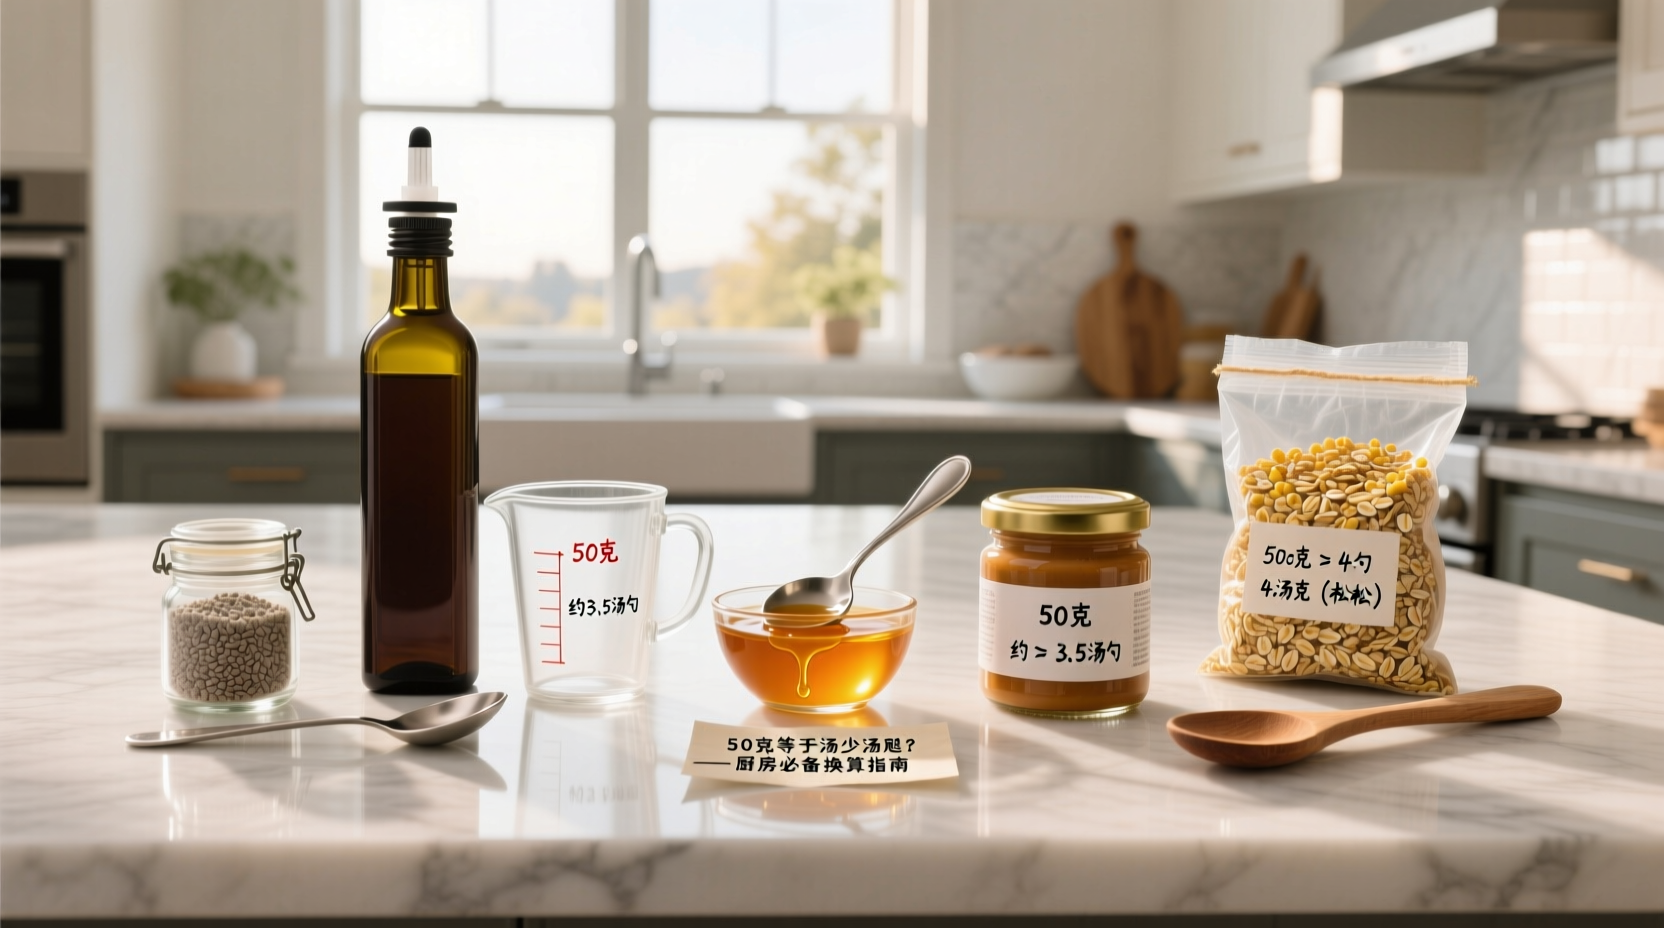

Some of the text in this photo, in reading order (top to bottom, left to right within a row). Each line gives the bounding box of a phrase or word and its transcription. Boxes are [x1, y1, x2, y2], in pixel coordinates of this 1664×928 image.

[572, 538, 619, 564] 50克
[1039, 601, 1092, 628] 50克
[1010, 639, 1029, 662] 约
[1055, 640, 1121, 664] 3.5汤勺
